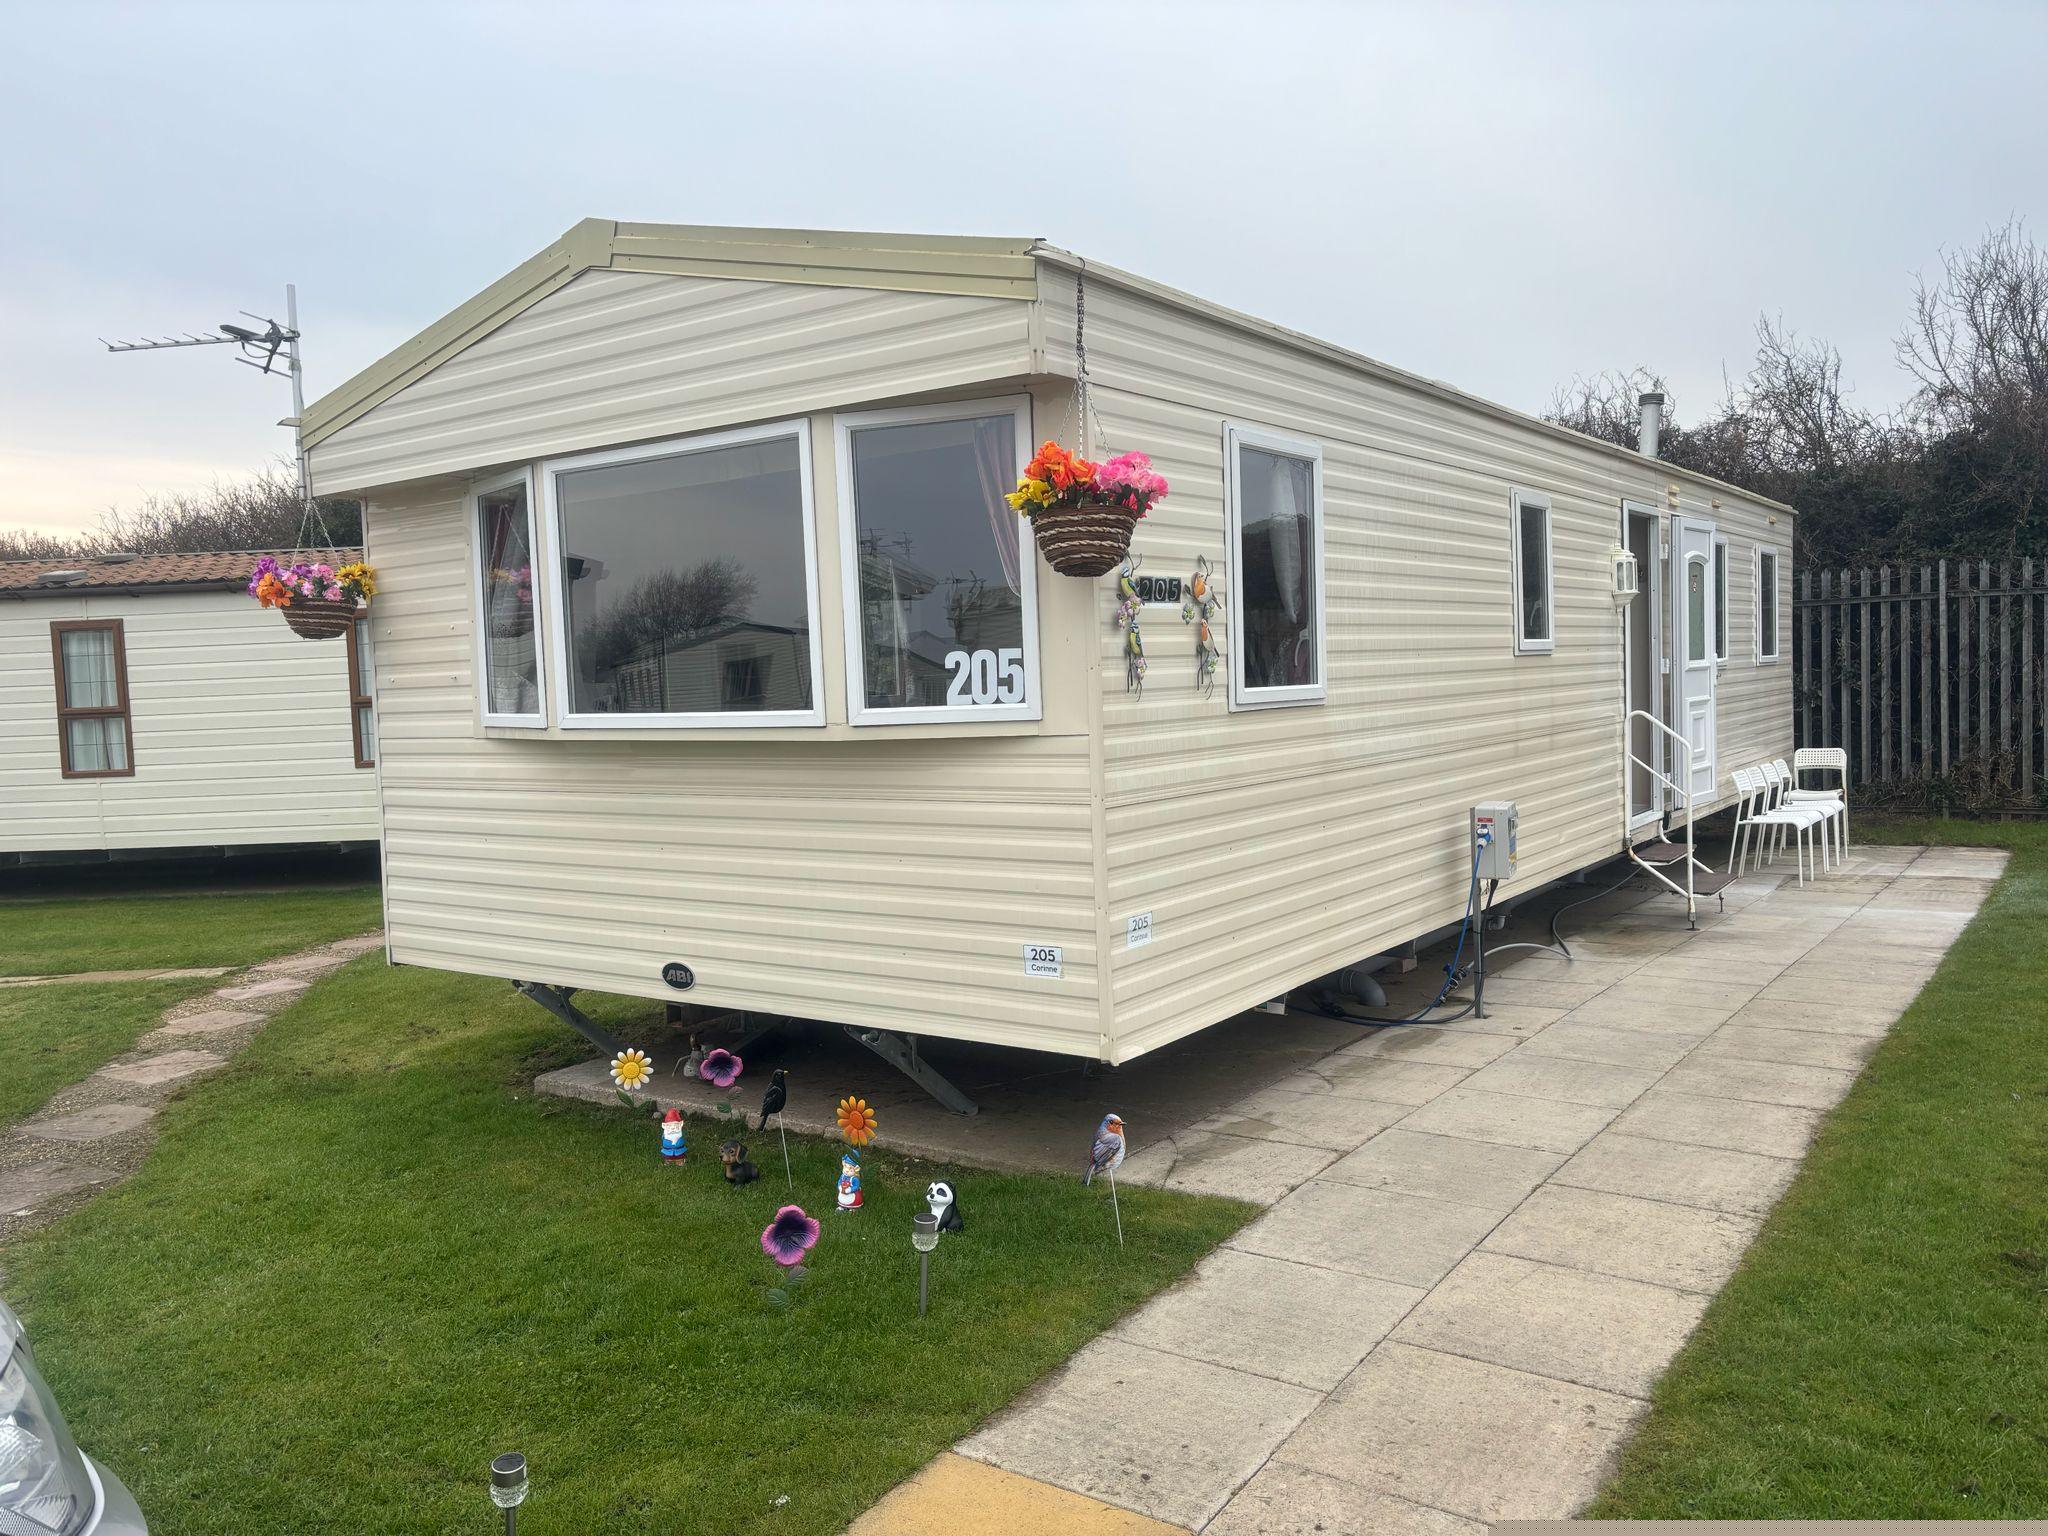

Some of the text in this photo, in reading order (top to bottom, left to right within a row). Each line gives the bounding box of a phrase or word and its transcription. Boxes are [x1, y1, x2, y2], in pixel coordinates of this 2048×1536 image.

[1141, 580, 1179, 600] 205
[944, 648, 1024, 706] 205
[1132, 917, 1149, 932] 205
[1030, 948, 1056, 962] 205
[1031, 963, 1058, 973] Corinne
